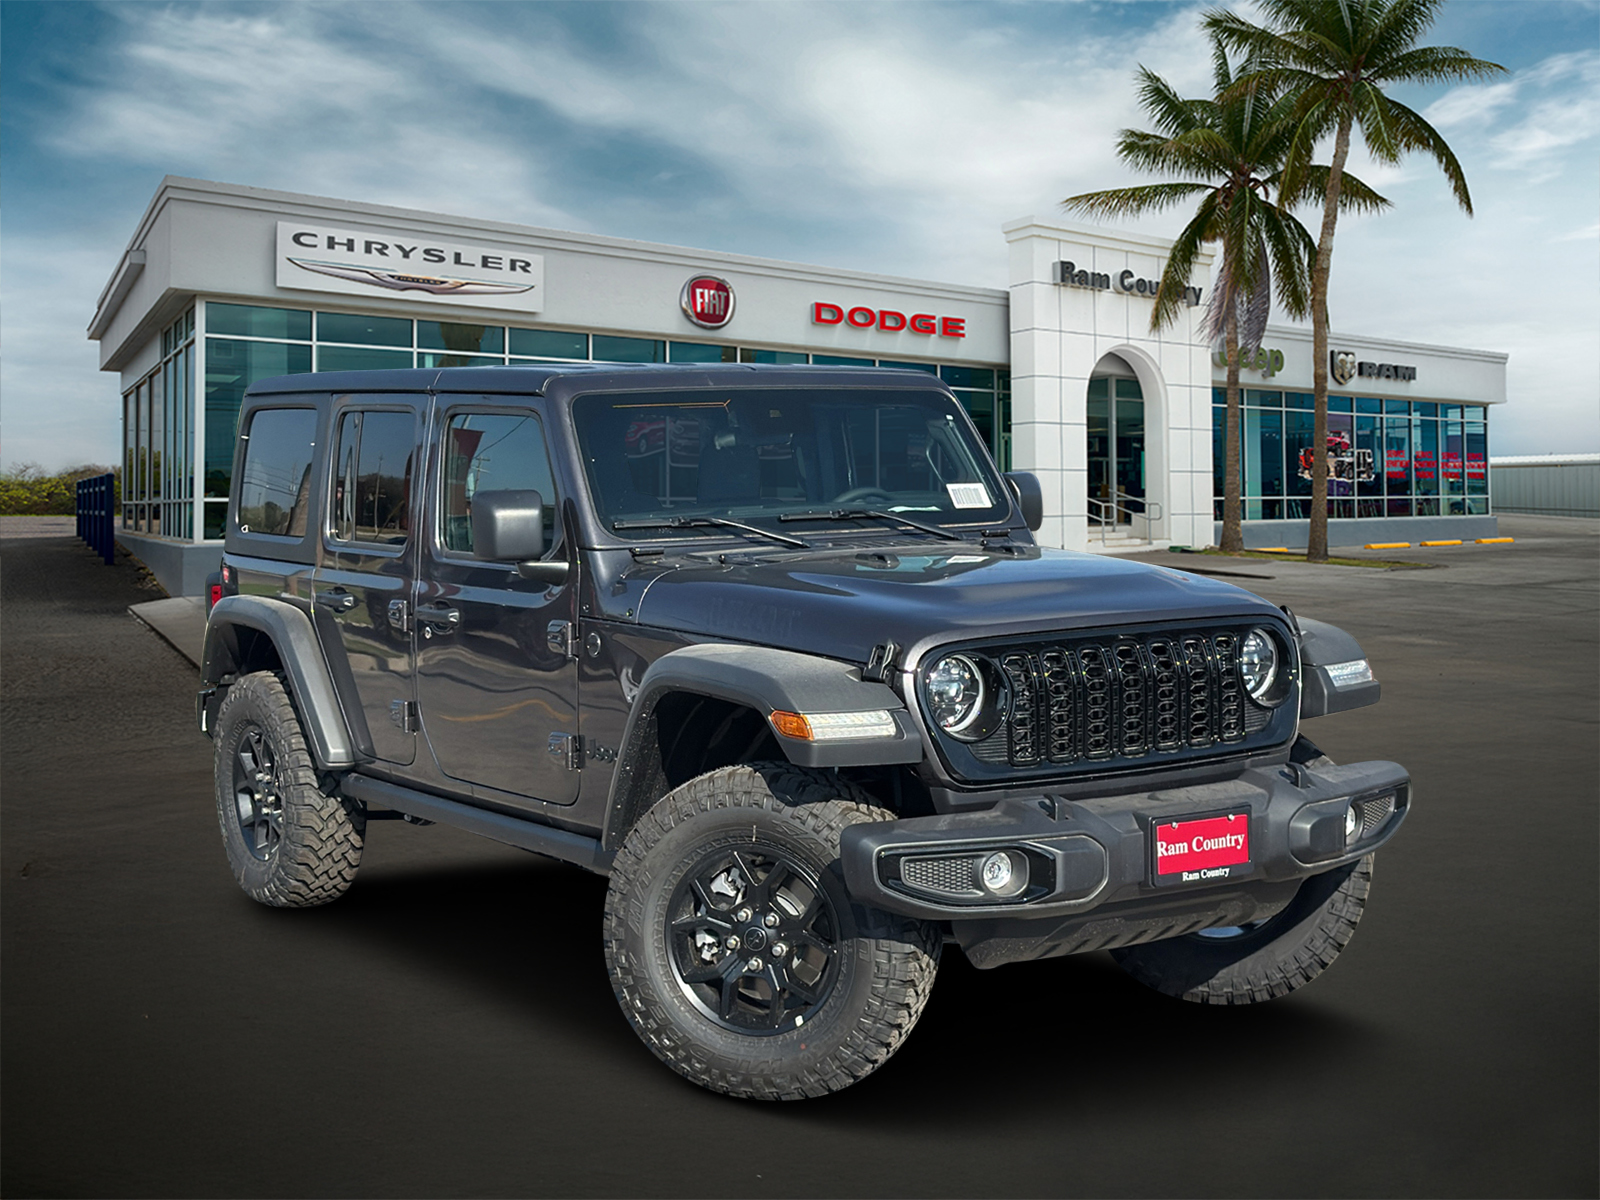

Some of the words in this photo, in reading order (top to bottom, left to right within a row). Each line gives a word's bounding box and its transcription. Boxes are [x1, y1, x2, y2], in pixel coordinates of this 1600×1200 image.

[291, 231, 533, 274] CHRYSLER
[1055, 260, 1111, 290] Ram
[1118, 269, 1203, 307] Coury
[695, 287, 728, 316] FIAT
[811, 301, 966, 338] DODGE
[1358, 361, 1417, 381] RAM
[1156, 841, 1189, 858] Ram
[1192, 833, 1245, 852] Country
[1182, 871, 1200, 882] Ram
[1201, 867, 1230, 879] Country
